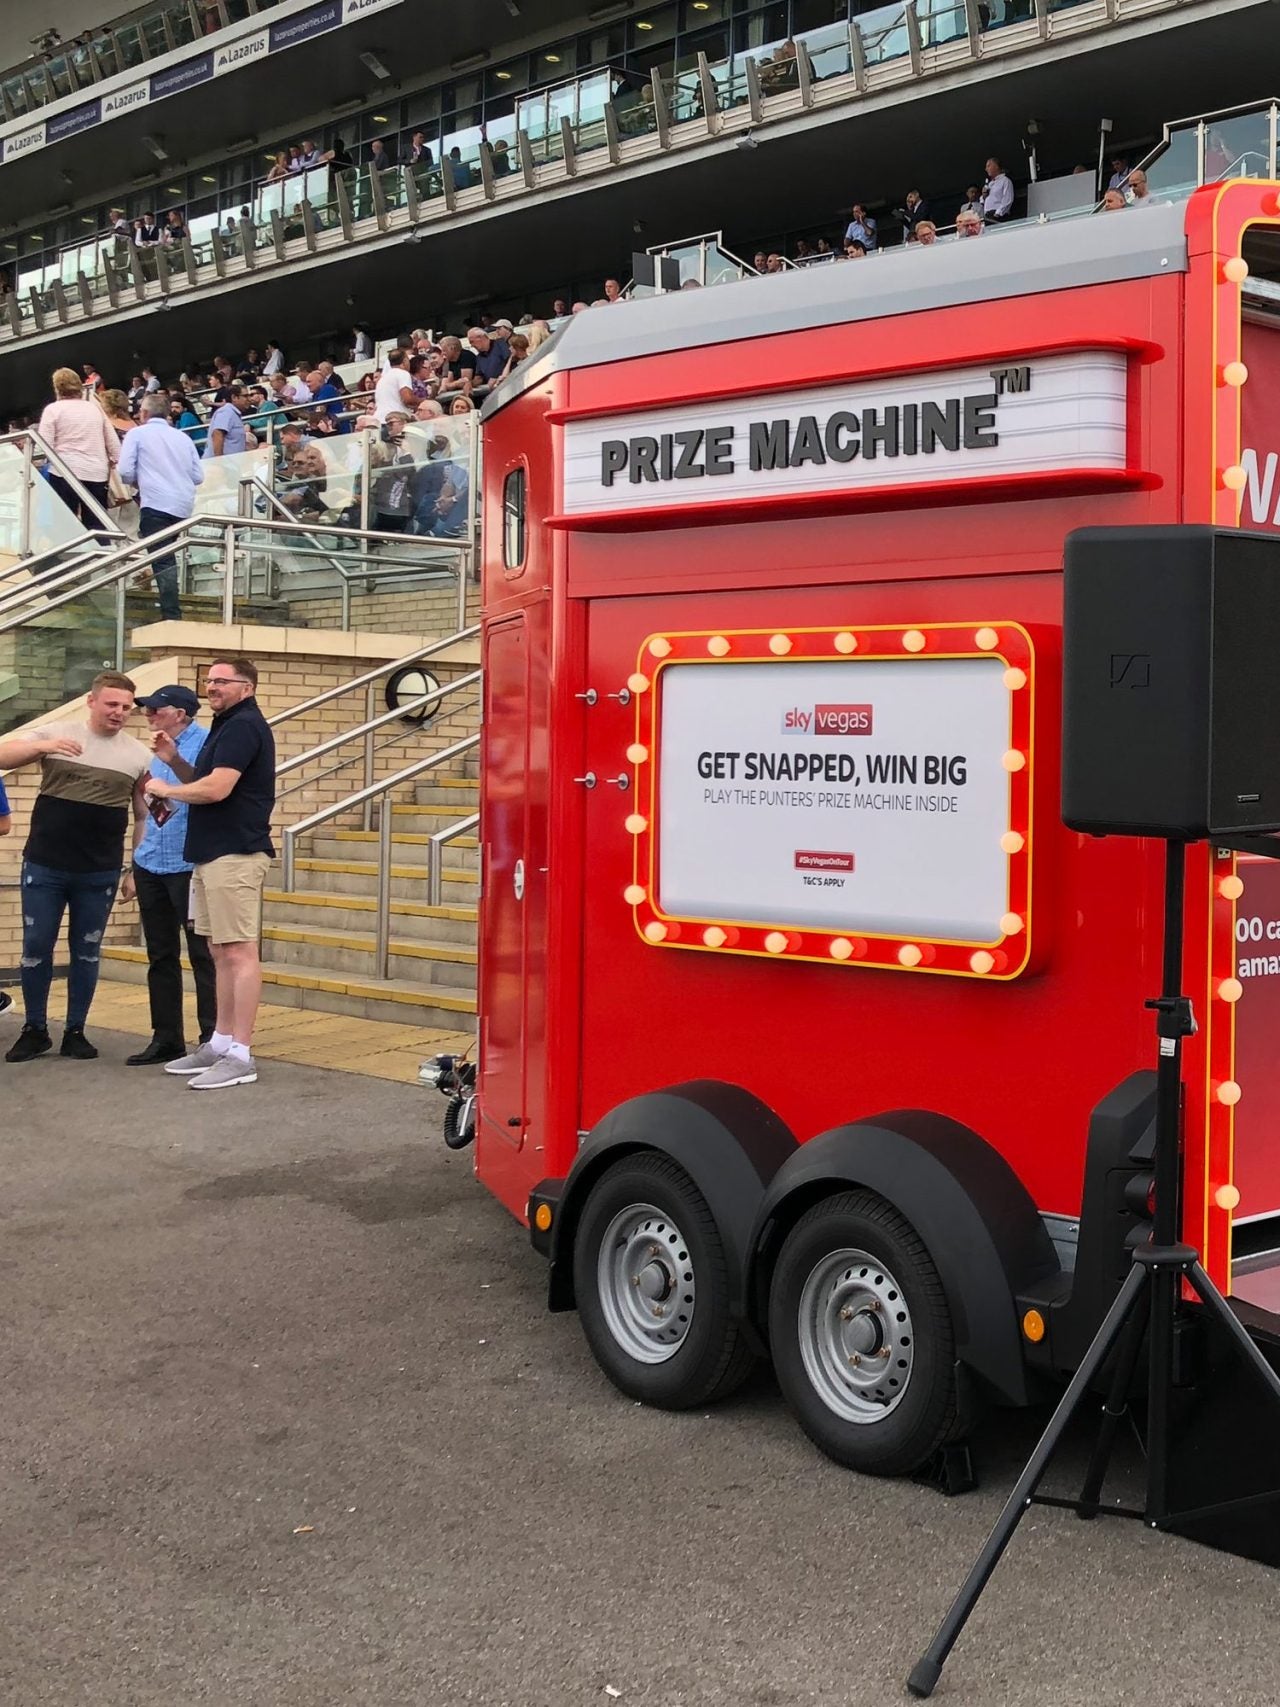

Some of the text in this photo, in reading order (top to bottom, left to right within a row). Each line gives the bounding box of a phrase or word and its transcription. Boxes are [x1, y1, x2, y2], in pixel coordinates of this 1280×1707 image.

[228, 39, 265, 63] Lazarus
[114, 88, 147, 110] Lazarus
[14, 131, 43, 151] Lazarus
[601, 426, 734, 487] PRIZE
[749, 393, 998, 471] MACHINE
[785, 707, 869, 733] sky vegas
[697, 752, 967, 787] GET SNAPPED, WIN BIG
[704, 788, 733, 804] PLAY
[734, 790, 756, 805] THE
[817, 793, 851, 808] PRIZE
[853, 794, 912, 811] MACHINE
[915, 796, 959, 812] INSIDE
[823, 878, 845, 887] APPLY
